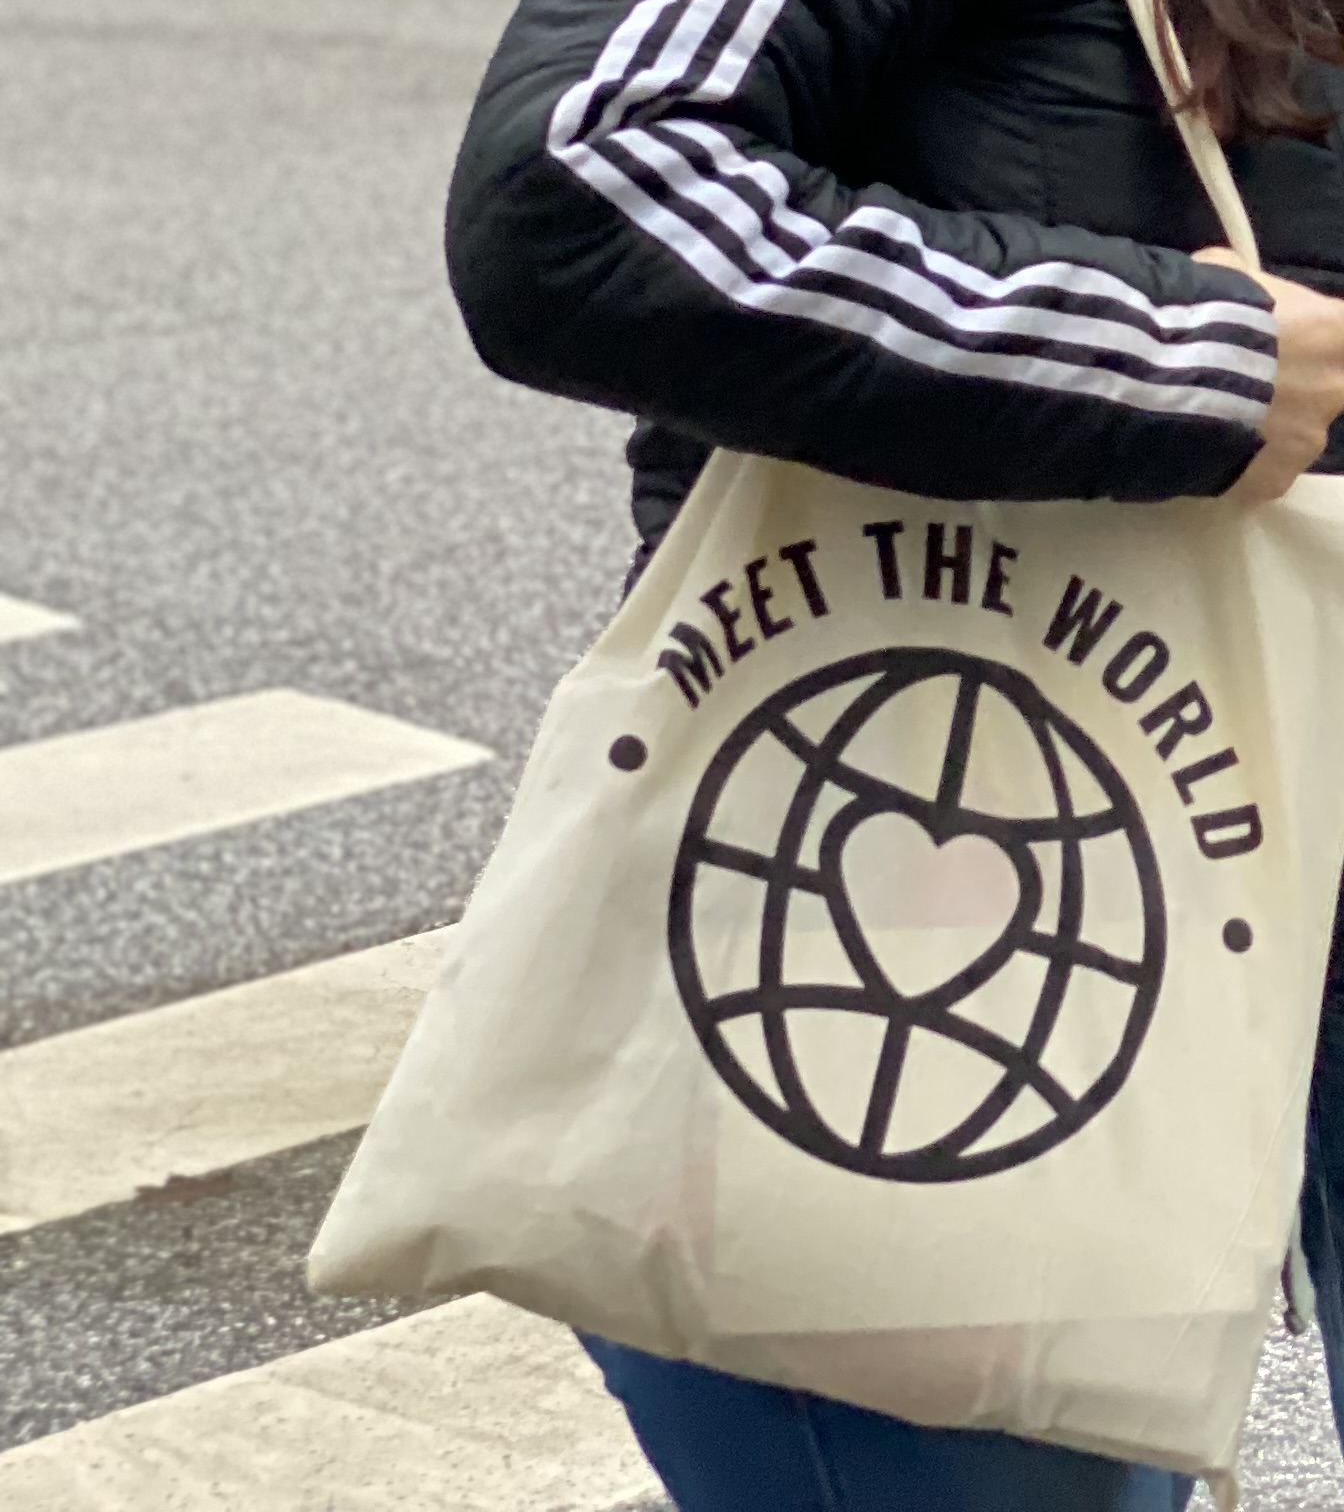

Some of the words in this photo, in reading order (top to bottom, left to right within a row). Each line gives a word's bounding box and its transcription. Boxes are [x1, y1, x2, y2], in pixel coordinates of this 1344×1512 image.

[656, 540, 829, 709] MEET
[862, 520, 1020, 616] THE
[1042, 574, 1266, 860] WORLD
